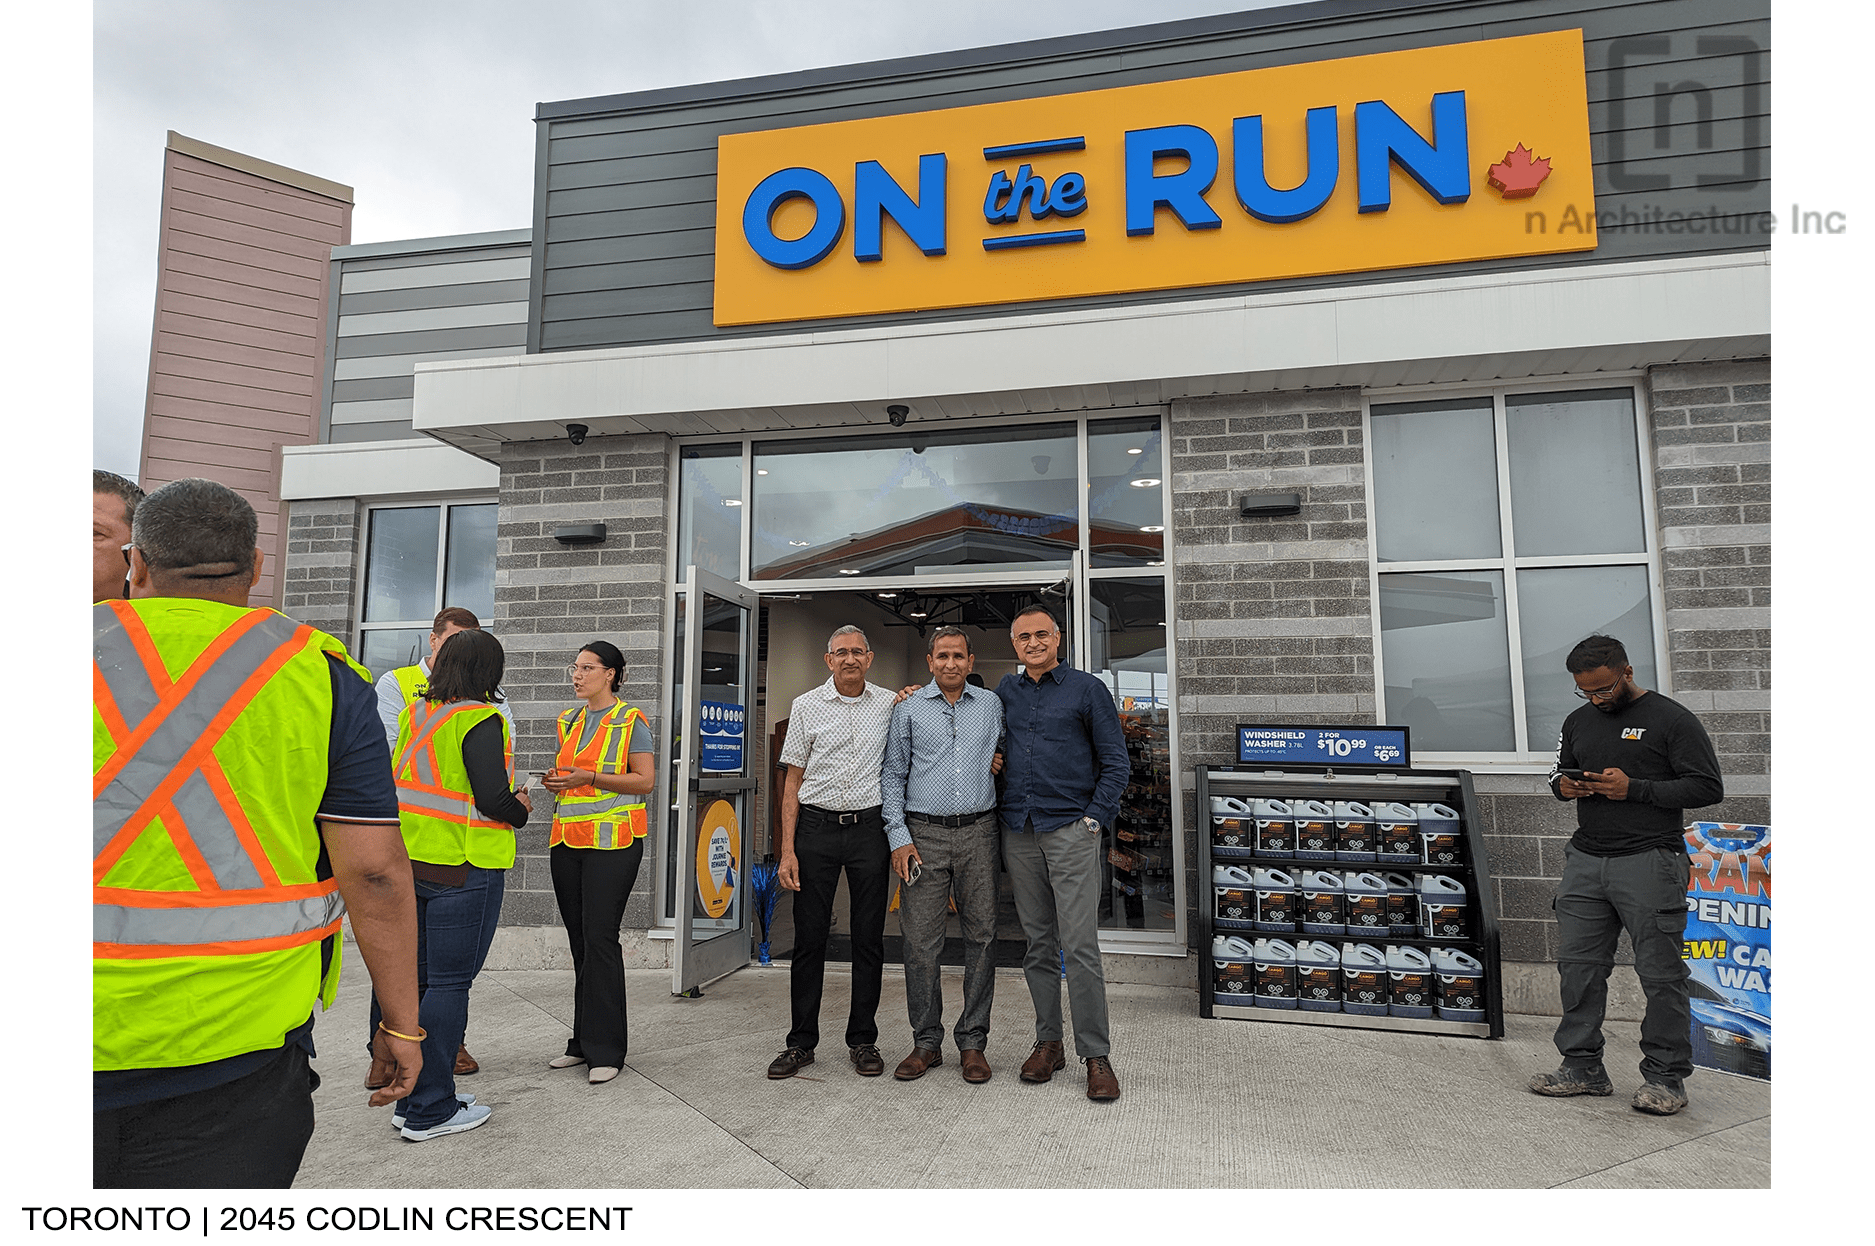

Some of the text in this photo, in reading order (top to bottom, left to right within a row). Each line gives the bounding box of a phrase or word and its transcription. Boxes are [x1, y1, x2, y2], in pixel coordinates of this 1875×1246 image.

[743, 87, 1471, 270] ON the RUN
[1244, 731, 1306, 740] WINDSHIELD
[1620, 727, 1647, 741] CAT
[1244, 740, 1287, 748] WASHER
[1716, 965, 1771, 993] WA
